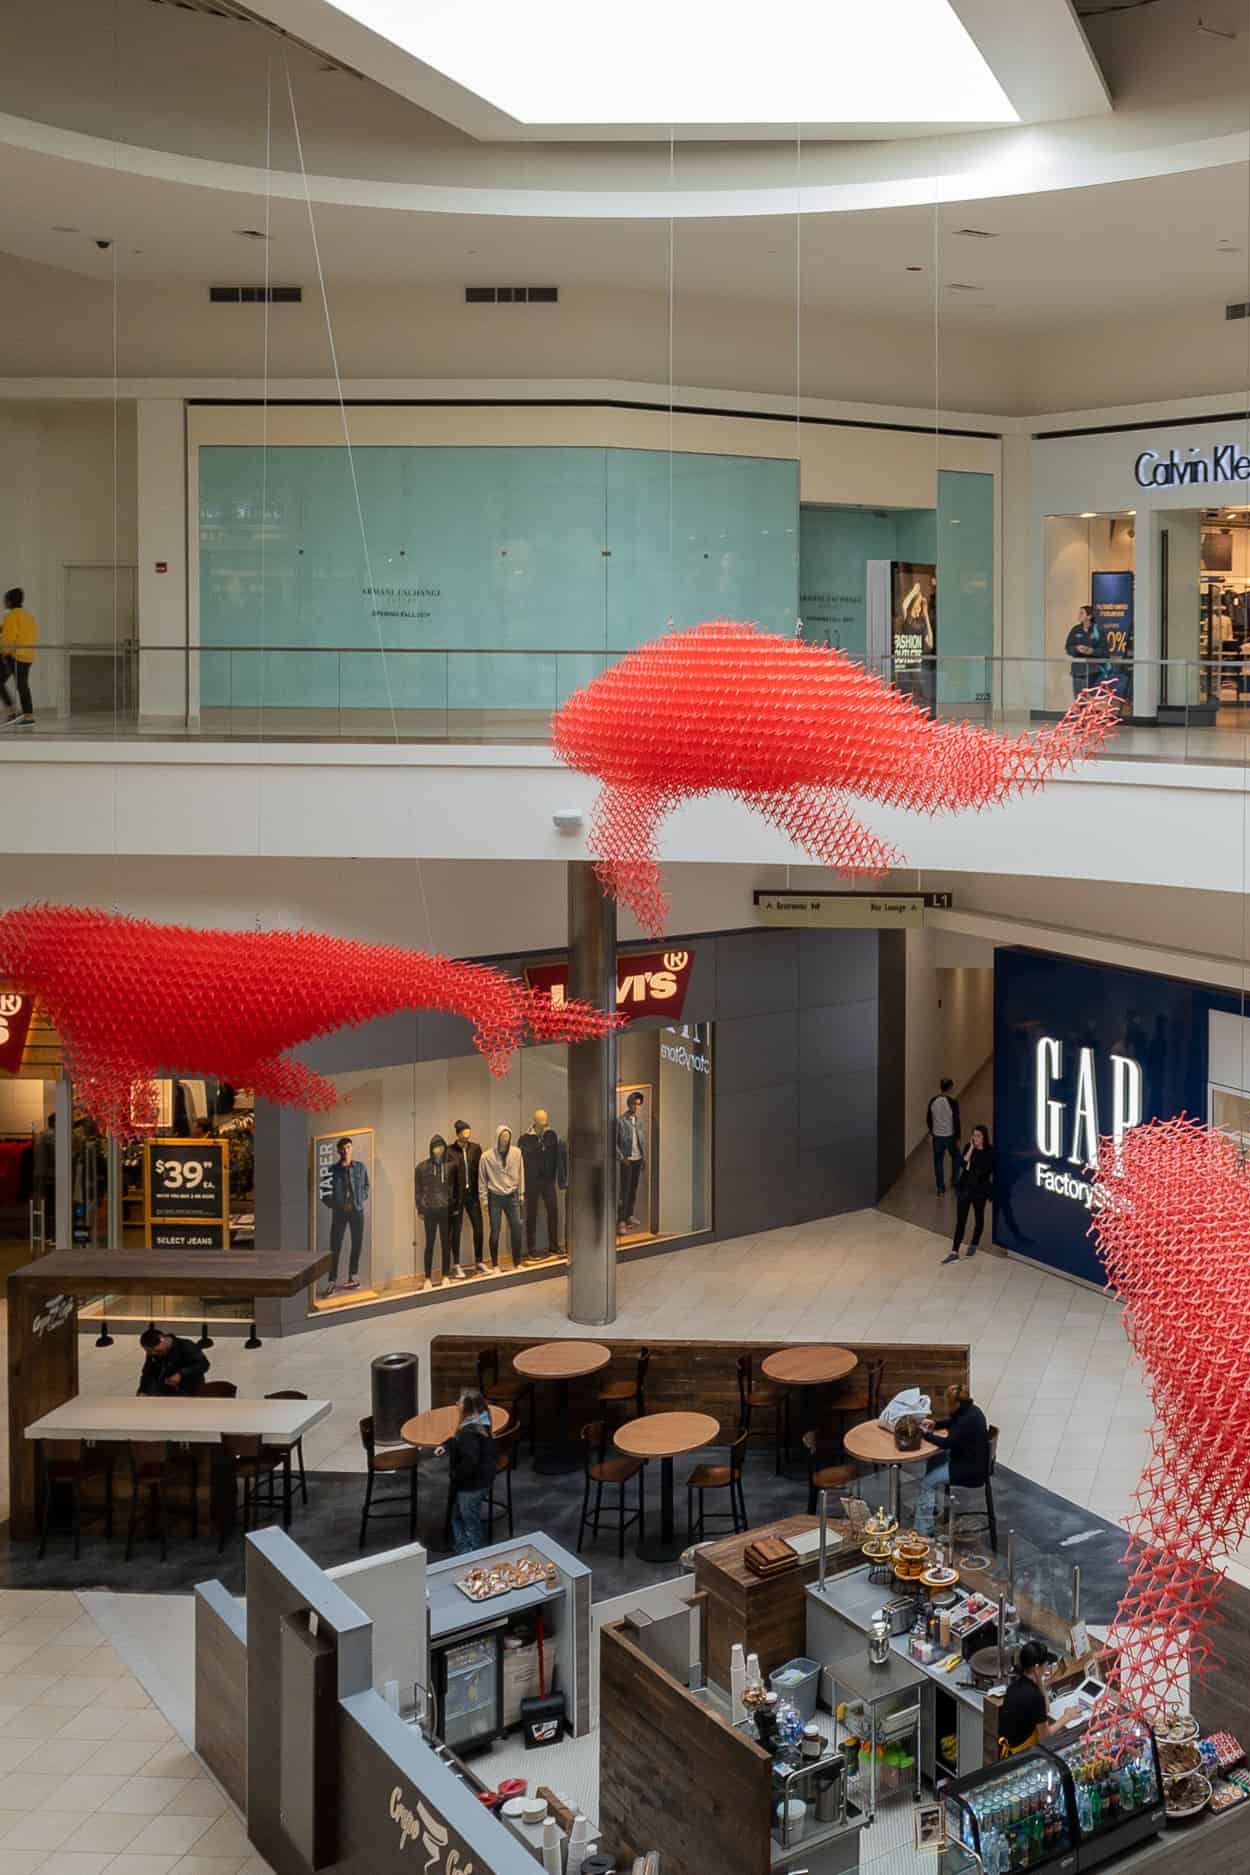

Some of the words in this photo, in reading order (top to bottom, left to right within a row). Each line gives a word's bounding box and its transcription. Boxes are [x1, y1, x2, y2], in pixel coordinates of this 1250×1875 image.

[1135, 447, 1209, 487] Calvin
[1107, 631, 1128, 653] 0%
[1036, 1036, 1143, 1178] GAP
[156, 1236, 185, 1245] SELECT
[187, 1237, 213, 1245] JEANS
